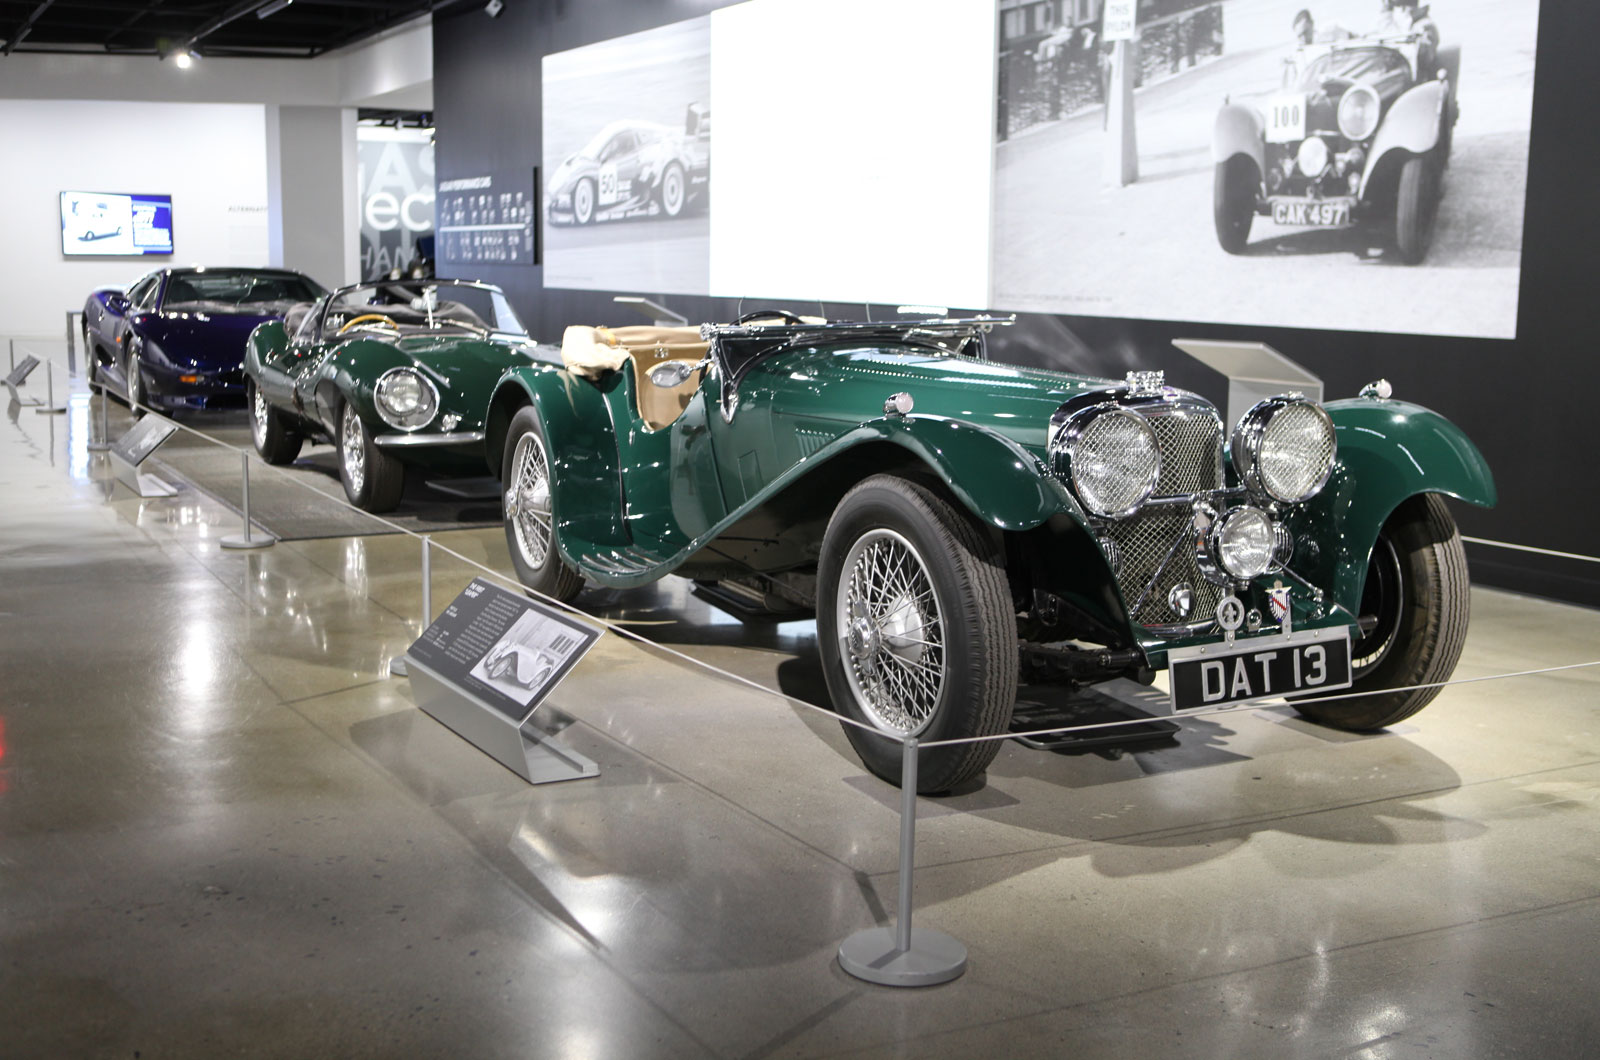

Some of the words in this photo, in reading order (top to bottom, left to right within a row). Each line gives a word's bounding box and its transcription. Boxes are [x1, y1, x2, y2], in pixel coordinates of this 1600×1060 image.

[1273, 105, 1299, 128] 100
[1275, 204, 1307, 225] CAK
[1309, 202, 1345, 225] 497
[1201, 651, 1278, 703] DAT
[1293, 645, 1327, 689] 13
